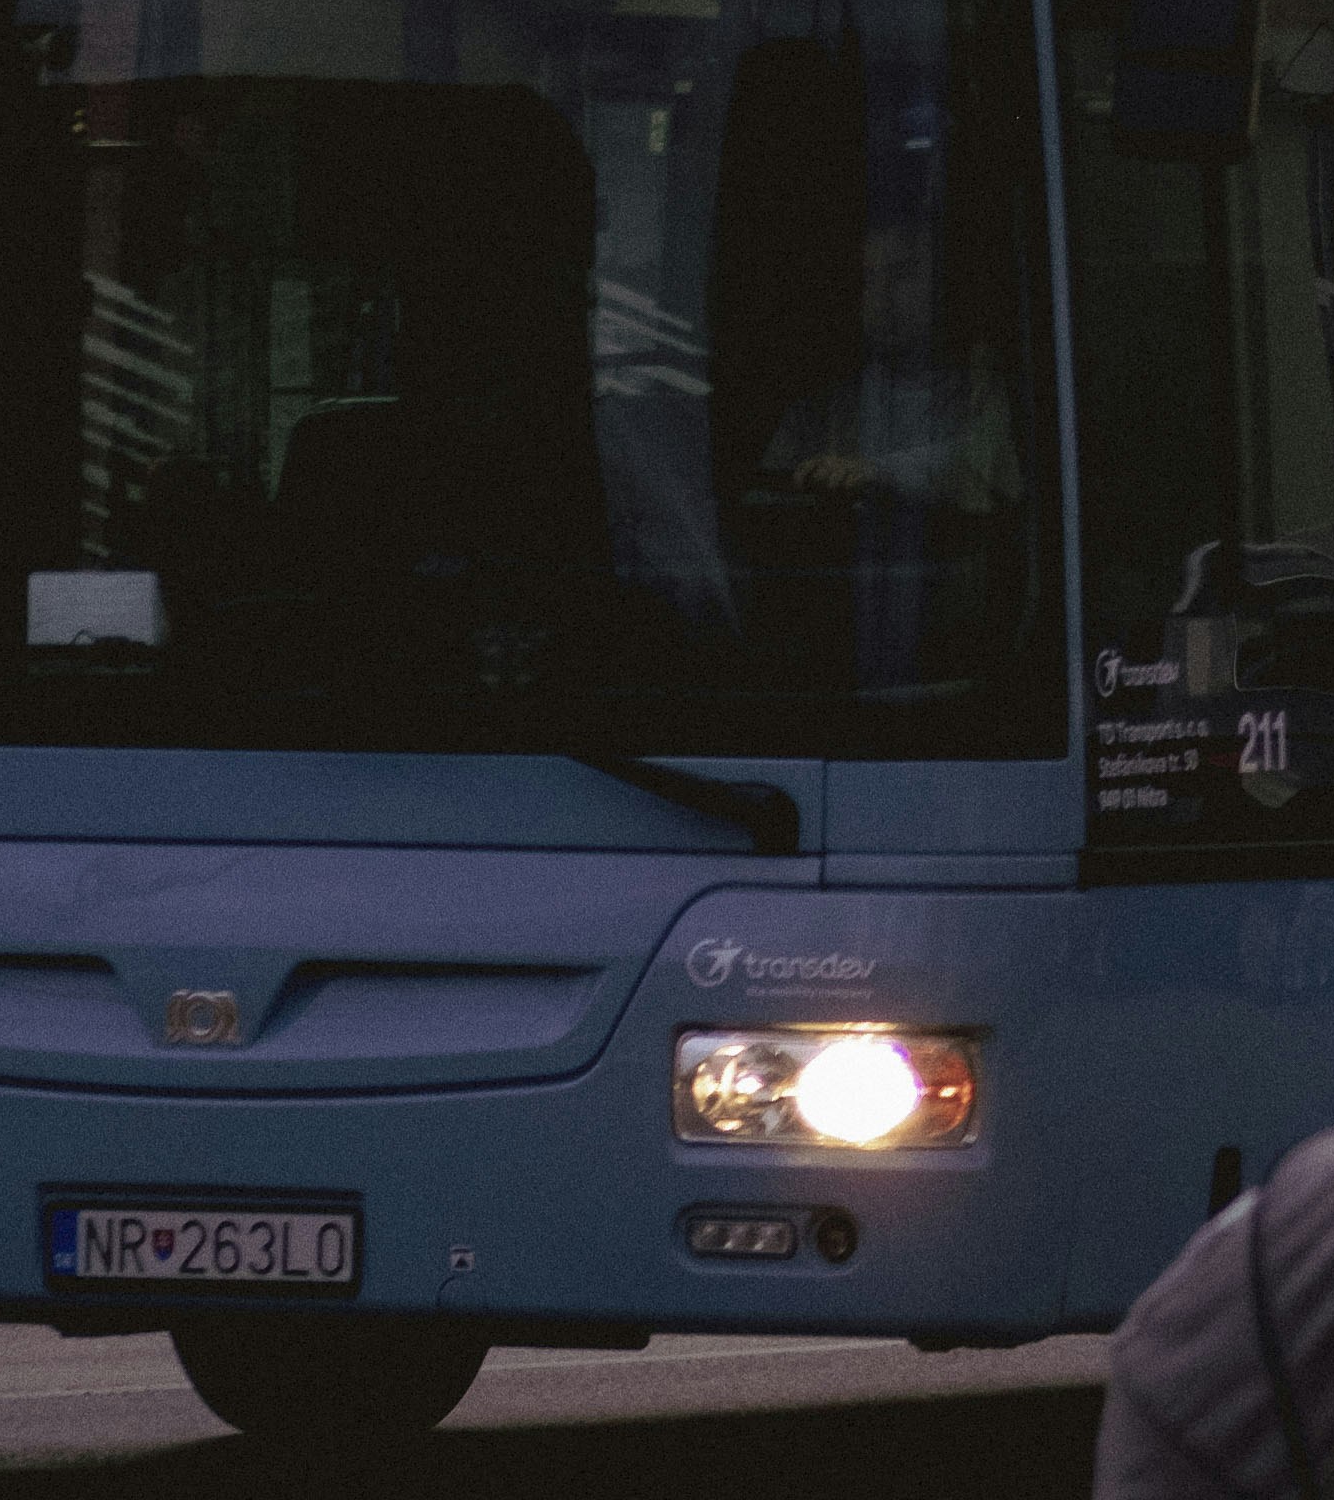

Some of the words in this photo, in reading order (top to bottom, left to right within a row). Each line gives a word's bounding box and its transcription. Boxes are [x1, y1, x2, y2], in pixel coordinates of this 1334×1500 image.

[1237, 709, 1289, 774] 211
[745, 953, 877, 981] transdev
[82, 1216, 147, 1275] NR
